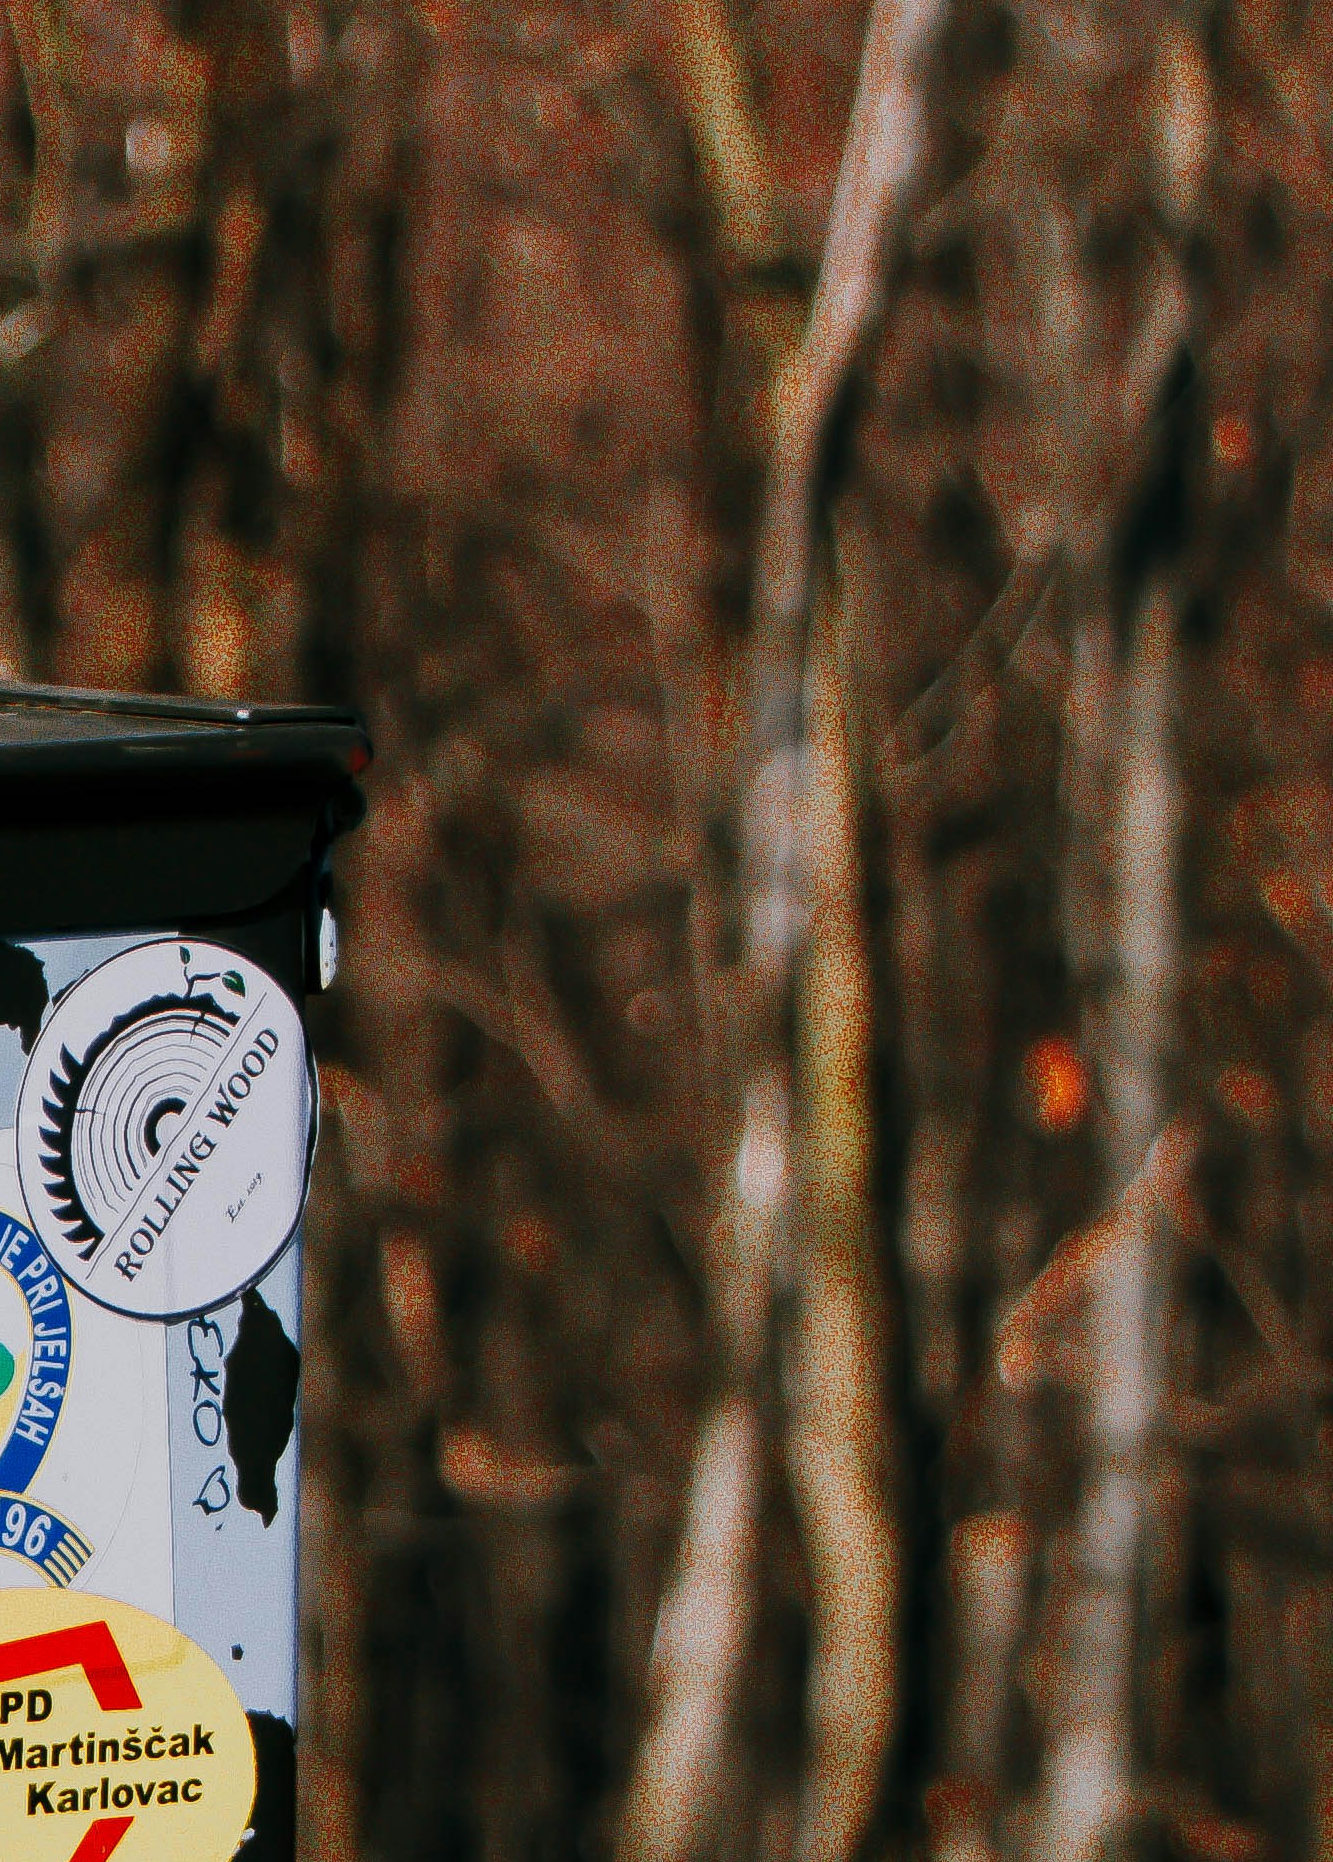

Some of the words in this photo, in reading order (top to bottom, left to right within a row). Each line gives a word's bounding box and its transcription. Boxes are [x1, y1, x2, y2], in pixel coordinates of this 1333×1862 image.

[113, 1130, 218, 1282] ROLLING
[206, 1027, 279, 1128] WOOD
[27, 1777, 203, 1816] Karlovac
